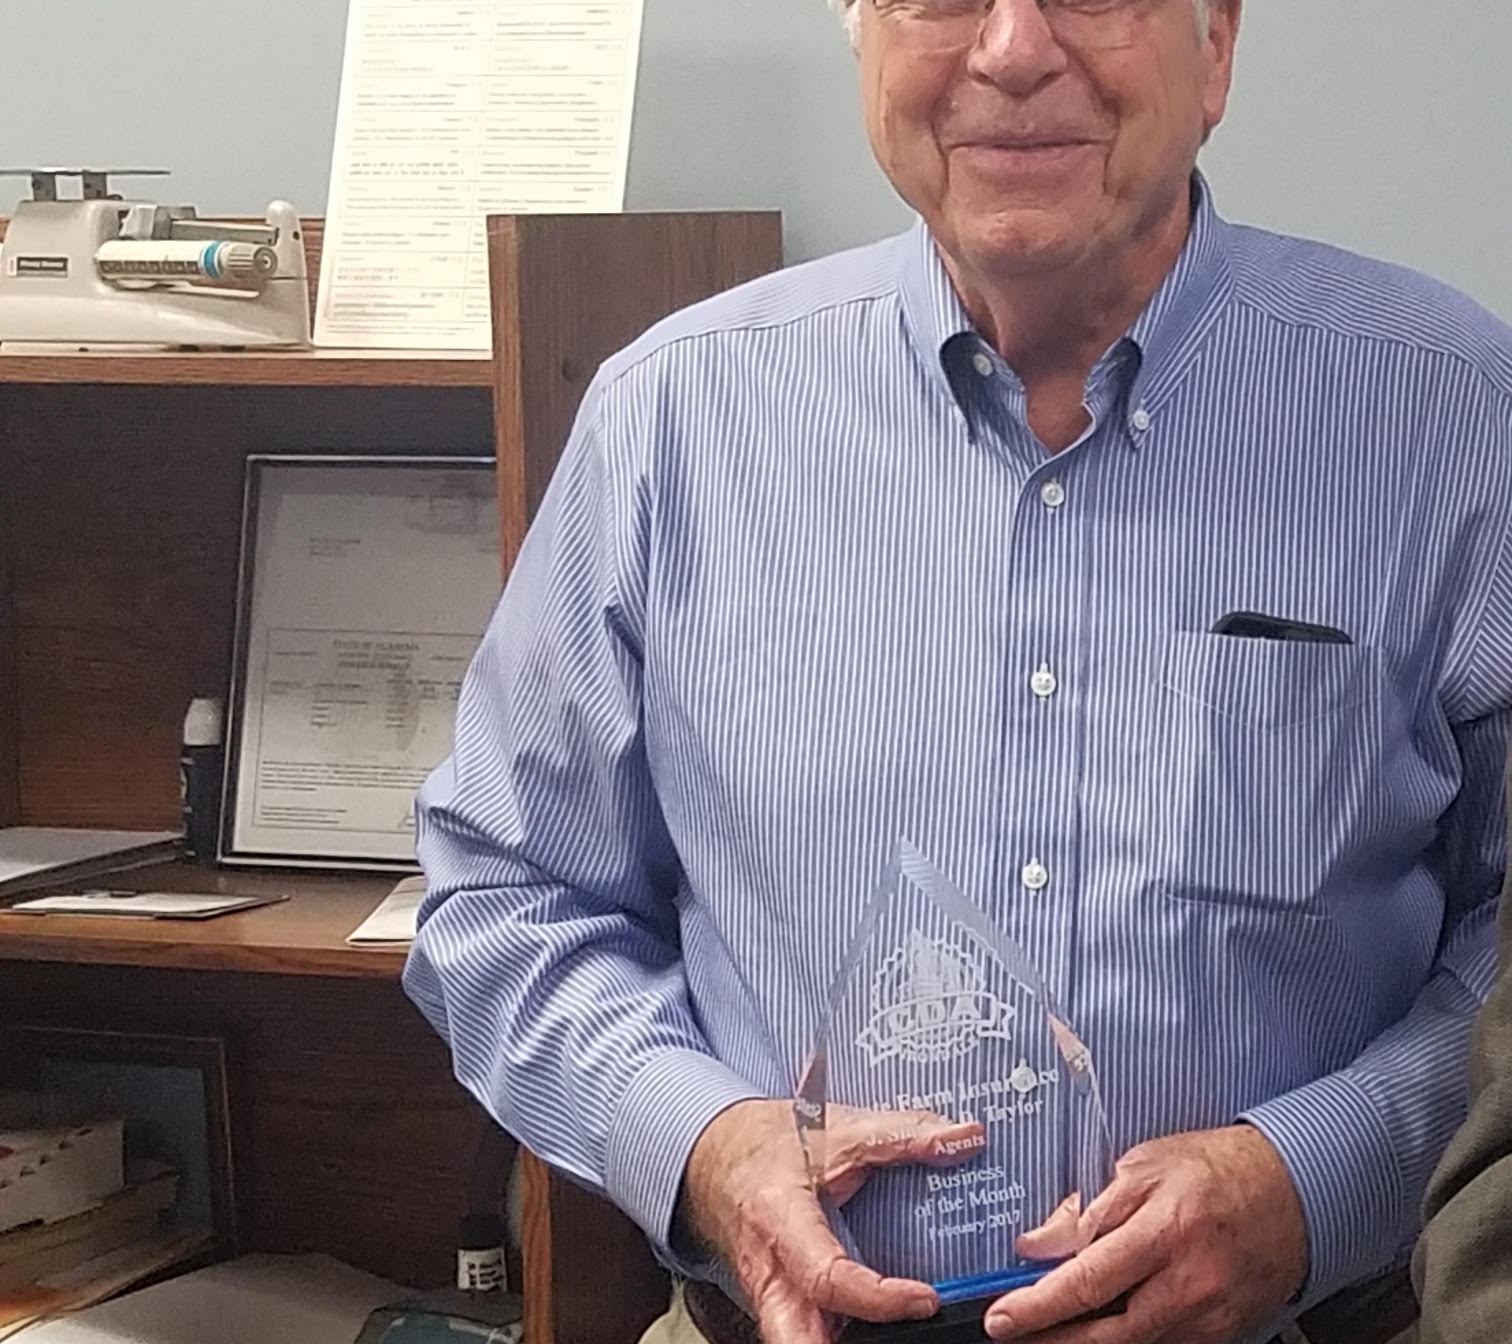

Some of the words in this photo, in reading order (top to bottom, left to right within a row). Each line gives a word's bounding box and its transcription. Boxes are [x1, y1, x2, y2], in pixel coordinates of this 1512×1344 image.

[897, 1090, 953, 1113] Farm
[958, 1068, 1059, 1099] Insurce
[983, 1098, 1044, 1123] Taylor
[934, 1134, 986, 1156] Agents
[927, 1165, 1005, 1193] Business
[914, 1197, 935, 1218] of
[938, 1195, 964, 1214] the
[968, 1180, 1026, 1208] Month
[987, 1209, 1021, 1229] 2017
